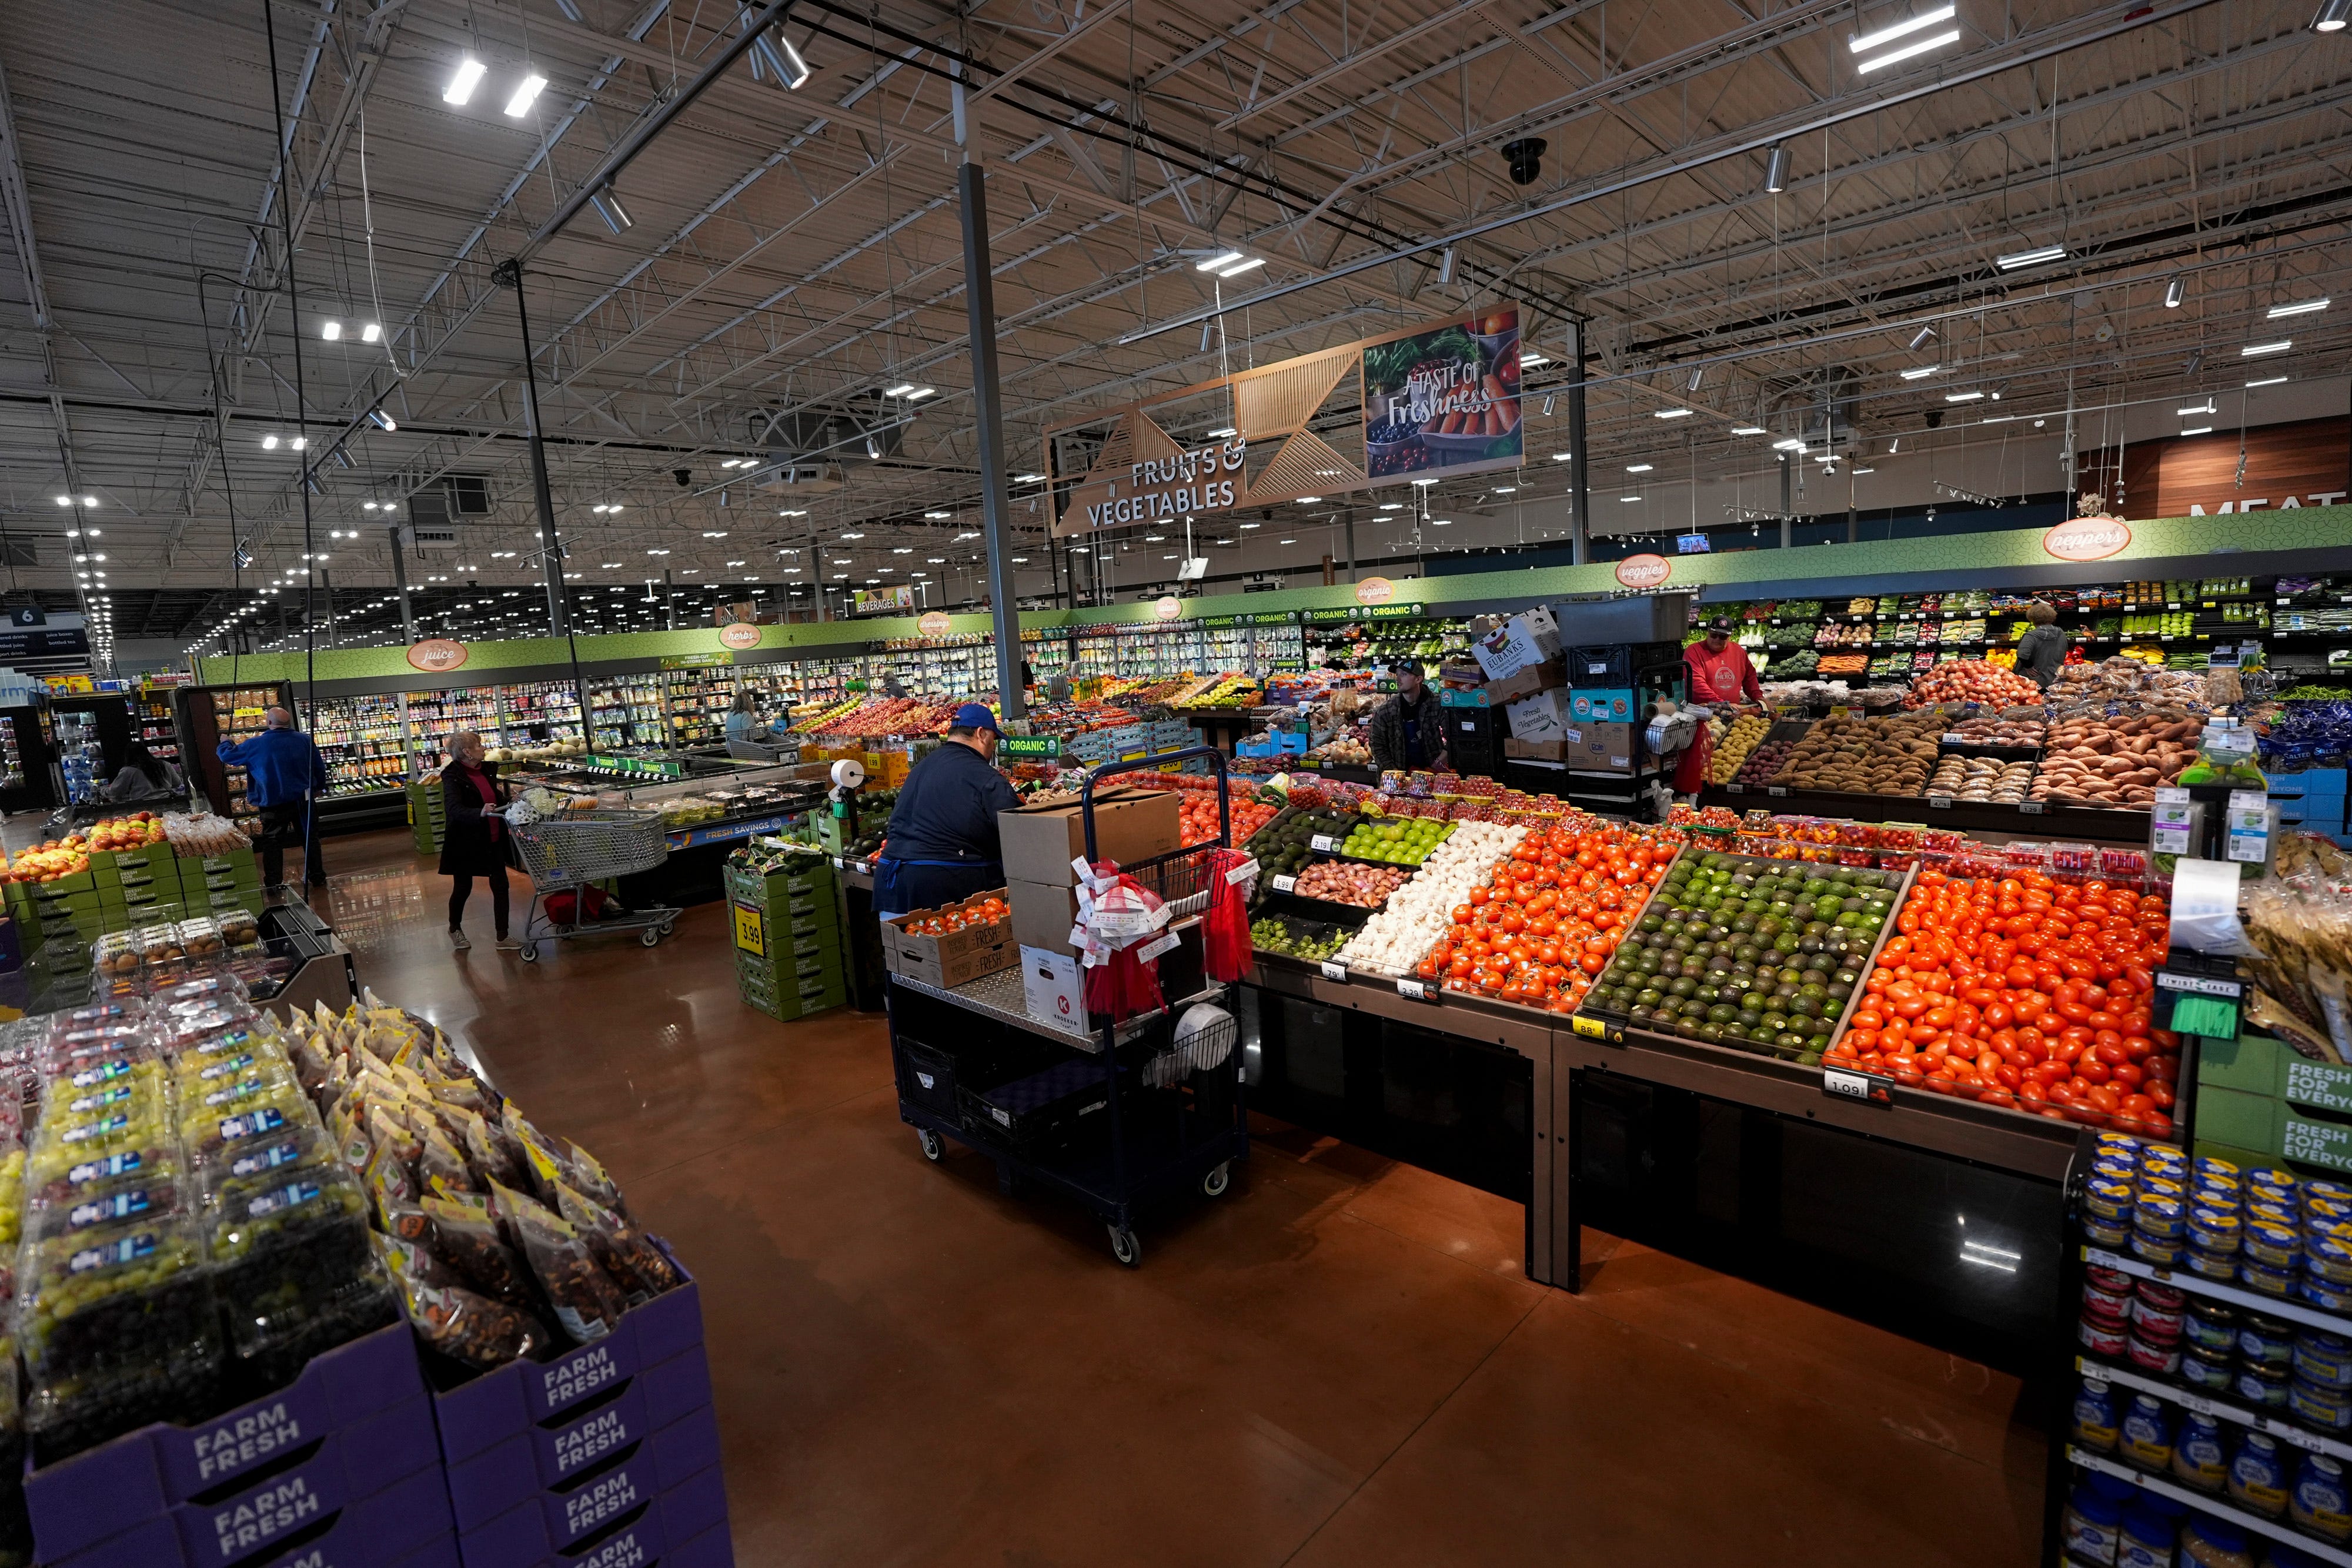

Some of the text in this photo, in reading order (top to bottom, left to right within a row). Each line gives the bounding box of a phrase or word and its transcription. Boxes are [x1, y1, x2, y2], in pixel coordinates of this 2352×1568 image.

[1403, 375, 1415, 395] A
[1416, 366, 1459, 394] TASTE
[1389, 385, 1492, 427] Freshness
[1132, 448, 1216, 487] FRUITS
[1087, 480, 1234, 527] VEGETABLES
[2049, 527, 2124, 550] peppers
[1622, 564, 1664, 580] veggies
[1358, 585, 1391, 599] organic
[857, 598, 896, 612] BEVERAGES
[1158, 603, 1178, 613] salads
[1372, 606, 1410, 616] ORGANIC
[22, 610, 34, 622] 6
[720, 614, 739, 626] SNACKS
[1205, 617, 1234, 626] ORGANIC
[1255, 613, 1287, 623] ORGANIC
[1313, 610, 1348, 620] ORGANIC
[920, 620, 950, 630] dressings
[728, 630, 754, 640] herbs
[420, 649, 456, 666] juice
[1488, 640, 1524, 669] EUBANKS
[1496, 652, 1522, 670] PRODUCE FARMS
[1523, 707, 1541, 718] Fresh
[1518, 714, 1551, 728] Vegetables
[1009, 740, 1045, 751] ORGANIC
[643, 763, 660, 773] ORGANIC
[871, 817, 887, 825] FARM
[706, 822, 770, 840] FRESH SAVINGS
[1315, 841, 1327, 849] 2.19
[1276, 880, 1289, 888] 3.99
[742, 922, 760, 945] 3.99
[975, 925, 998, 947] FRESH
[947, 935, 968, 948] INSPIRED
[949, 945, 967, 955] FLAVOR
[950, 962, 971, 973] INSPIRED
[980, 952, 1002, 973] FRESH
[953, 970, 971, 981] FLAVOR
[1402, 988, 1419, 997] 2.29
[2165, 978, 2230, 992] TWIST EASE
[1058, 998, 1067, 1011] K
[1054, 1015, 1078, 1026] KROEKER
[1581, 1025, 1595, 1034] 88¢
[2289, 1062, 2351, 1085] FRESH
[1833, 1082, 1859, 1095] 1.09
[2288, 1074, 2329, 1092] FOR
[2286, 1086, 2352, 1109] EVERY
[2286, 1121, 2348, 1144] FRESH
[2285, 1133, 2325, 1151] FOR
[543, 1346, 607, 1389] FARM
[547, 1360, 616, 1407] FRESH
[193, 1403, 286, 1459] FARM
[554, 1410, 617, 1455] FARM
[199, 1419, 300, 1481] FRESH
[558, 1424, 626, 1472] FRESH
[566, 1472, 627, 1517] FARM
[214, 1477, 306, 1536] FARM
[569, 1485, 636, 1534] FRESH
[219, 1492, 319, 1557] FRESH
